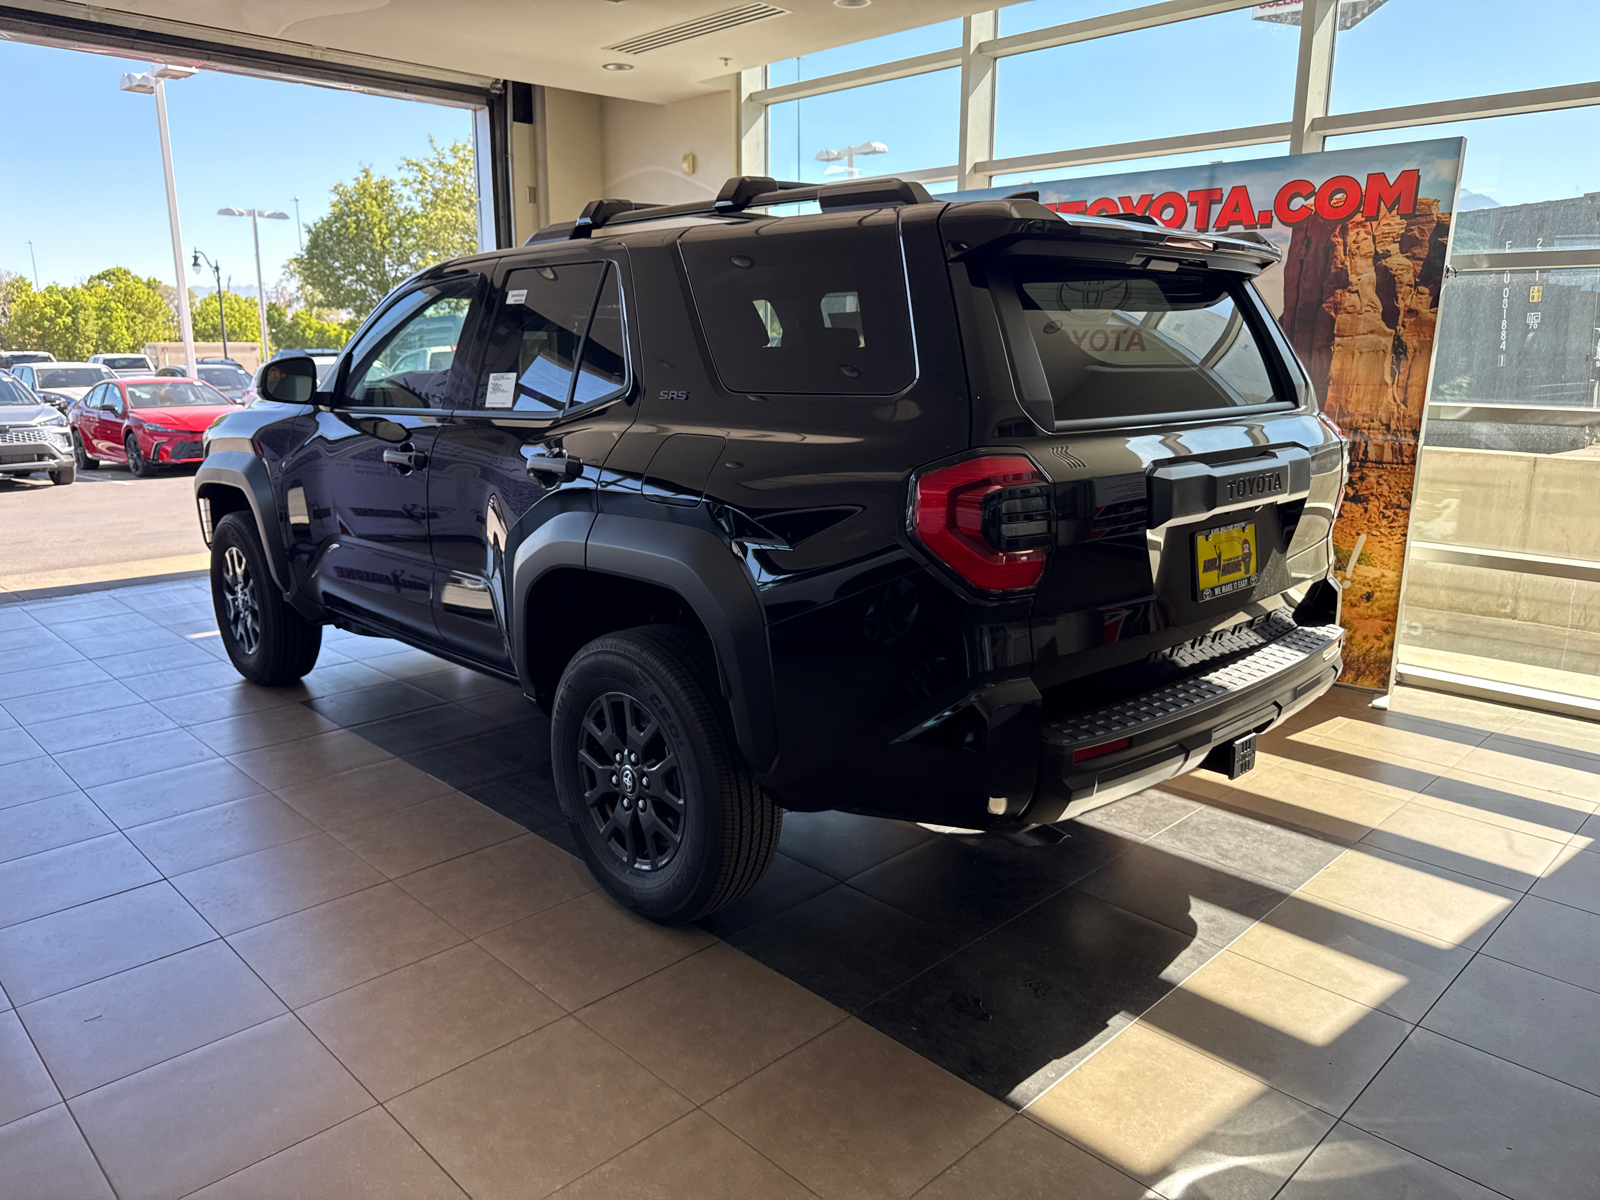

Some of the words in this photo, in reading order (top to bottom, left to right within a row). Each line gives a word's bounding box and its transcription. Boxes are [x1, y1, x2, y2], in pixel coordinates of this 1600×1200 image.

[1043, 168, 1420, 231] TYOTA.COM
[659, 390, 689, 400] SR5
[1226, 471, 1282, 500] TOYOTA
